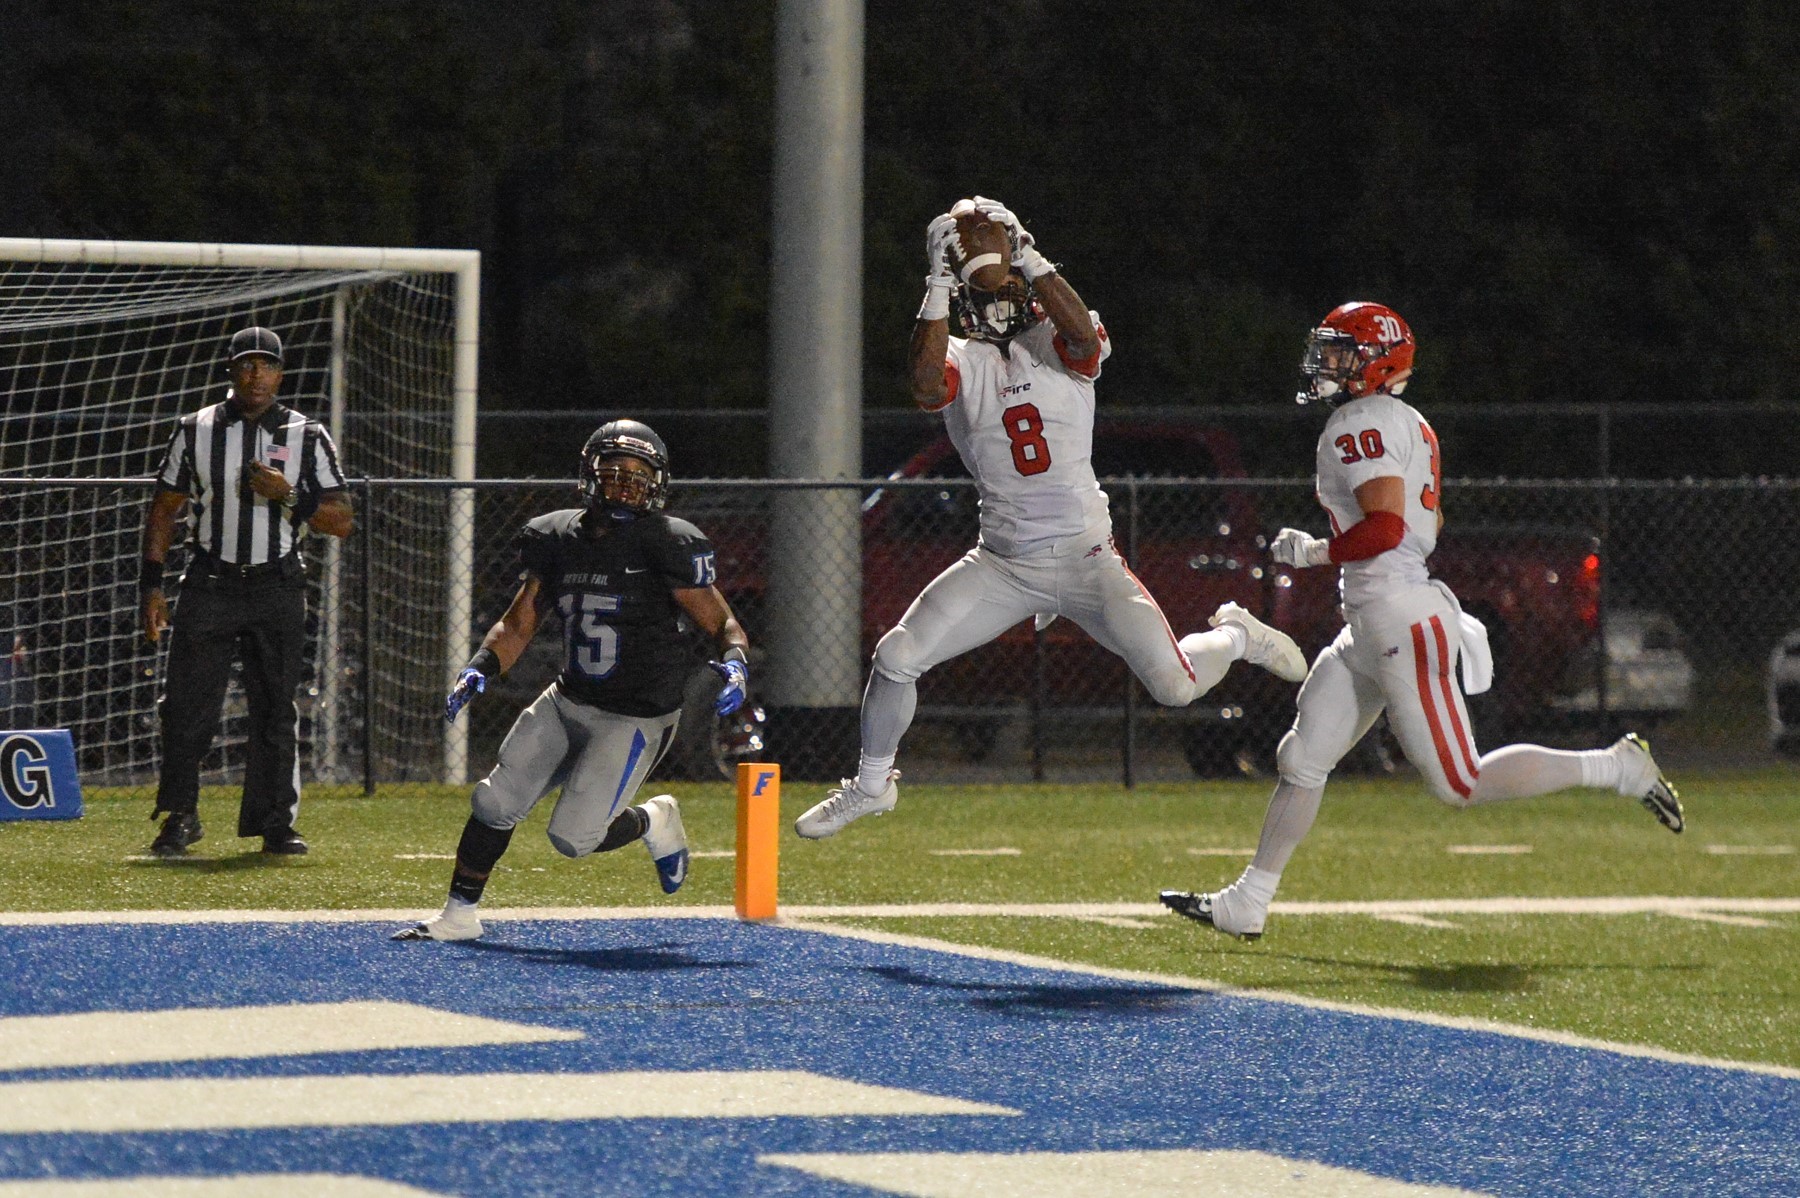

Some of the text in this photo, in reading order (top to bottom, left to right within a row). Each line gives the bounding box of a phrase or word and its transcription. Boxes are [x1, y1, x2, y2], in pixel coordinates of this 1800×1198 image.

[1373, 315, 1402, 343] 30
[999, 382, 1031, 398] Fire
[1002, 402, 1052, 477] 8
[1335, 428, 1385, 465] 30
[693, 554, 716, 586] 15
[557, 592, 622, 679] 15
[0, 734, 56, 810] G
[752, 772, 775, 797] F
